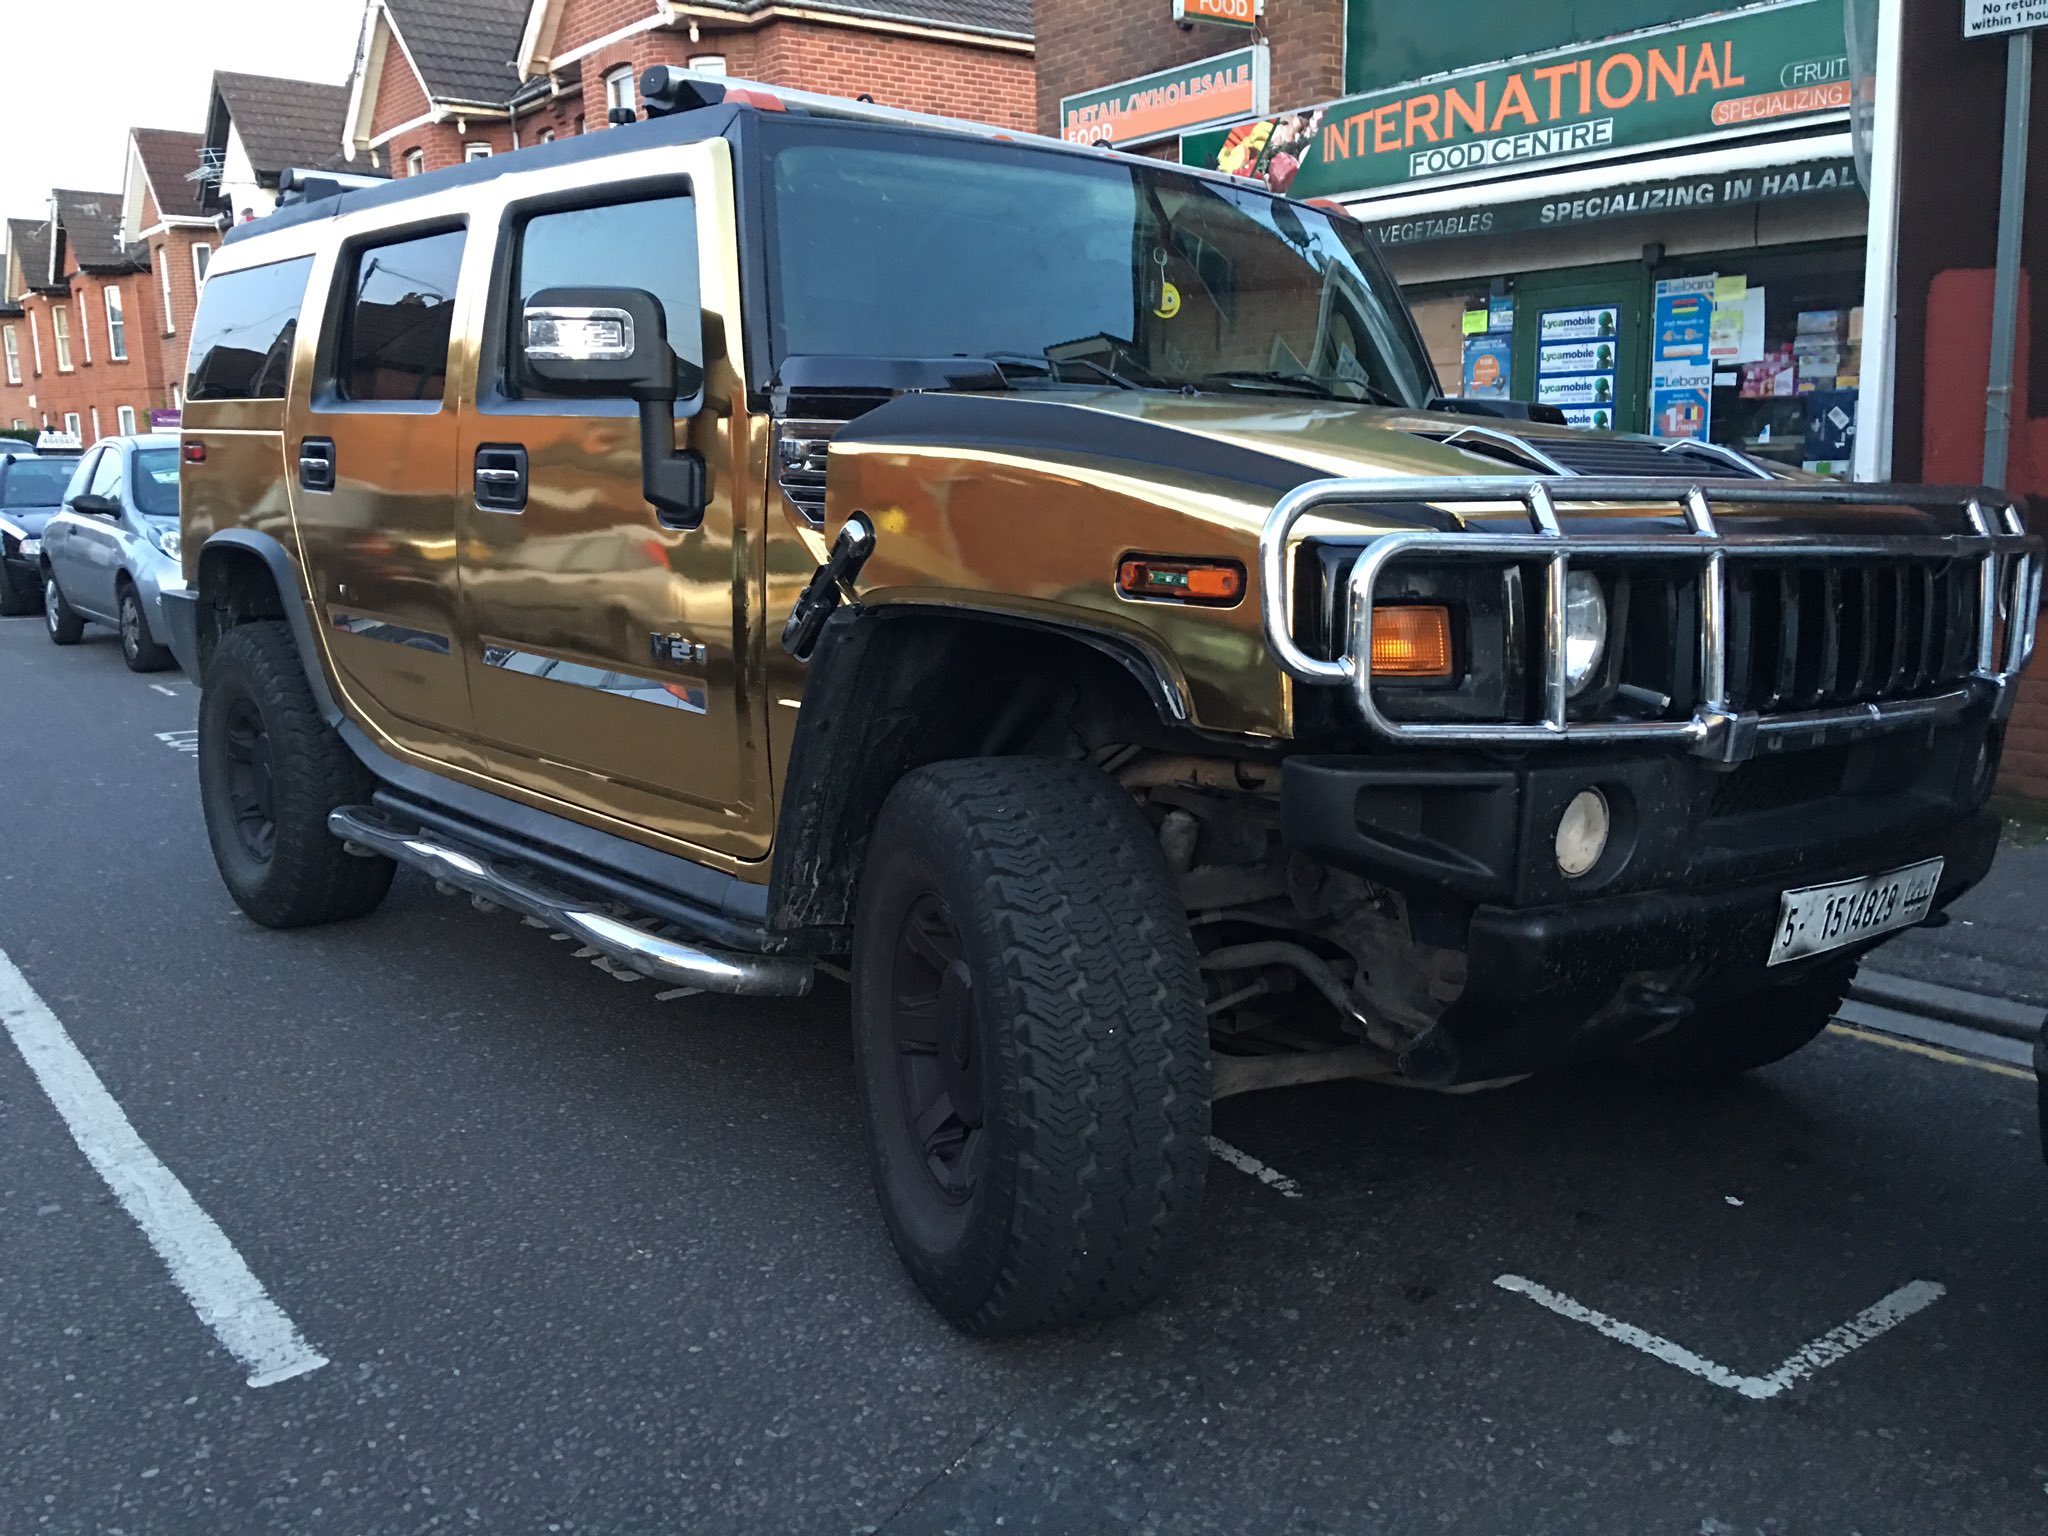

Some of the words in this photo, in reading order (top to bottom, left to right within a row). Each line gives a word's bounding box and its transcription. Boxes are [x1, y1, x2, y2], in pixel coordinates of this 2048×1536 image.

[1983, 3, 2001, 15] No
[2005, 0, 2046, 11] return
[1971, 15, 2012, 30] within
[2016, 12, 2022, 22] 1
[2026, 11, 2048, 21] hou
[1793, 57, 1847, 84] FRUIT
[1322, 40, 1745, 163] INTERNATIONAL
[1718, 85, 1843, 122] SPECIALIZING
[1067, 122, 1113, 146] FOOD
[1412, 141, 1486, 176] FOOD
[1491, 119, 1612, 160] CENTRE
[1540, 183, 1714, 224] SPECIALIZING
[1723, 177, 1752, 201] IN
[1760, 166, 1855, 196] HALAL
[1379, 212, 1494, 244] VEGETABLES
[1668, 279, 1714, 293] Lebara
[1542, 316, 1596, 330] Lycamobile
[1541, 348, 1594, 362] Lycamobile
[1540, 381, 1593, 395] Lycamobile
[1665, 376, 1710, 388] Lebara
